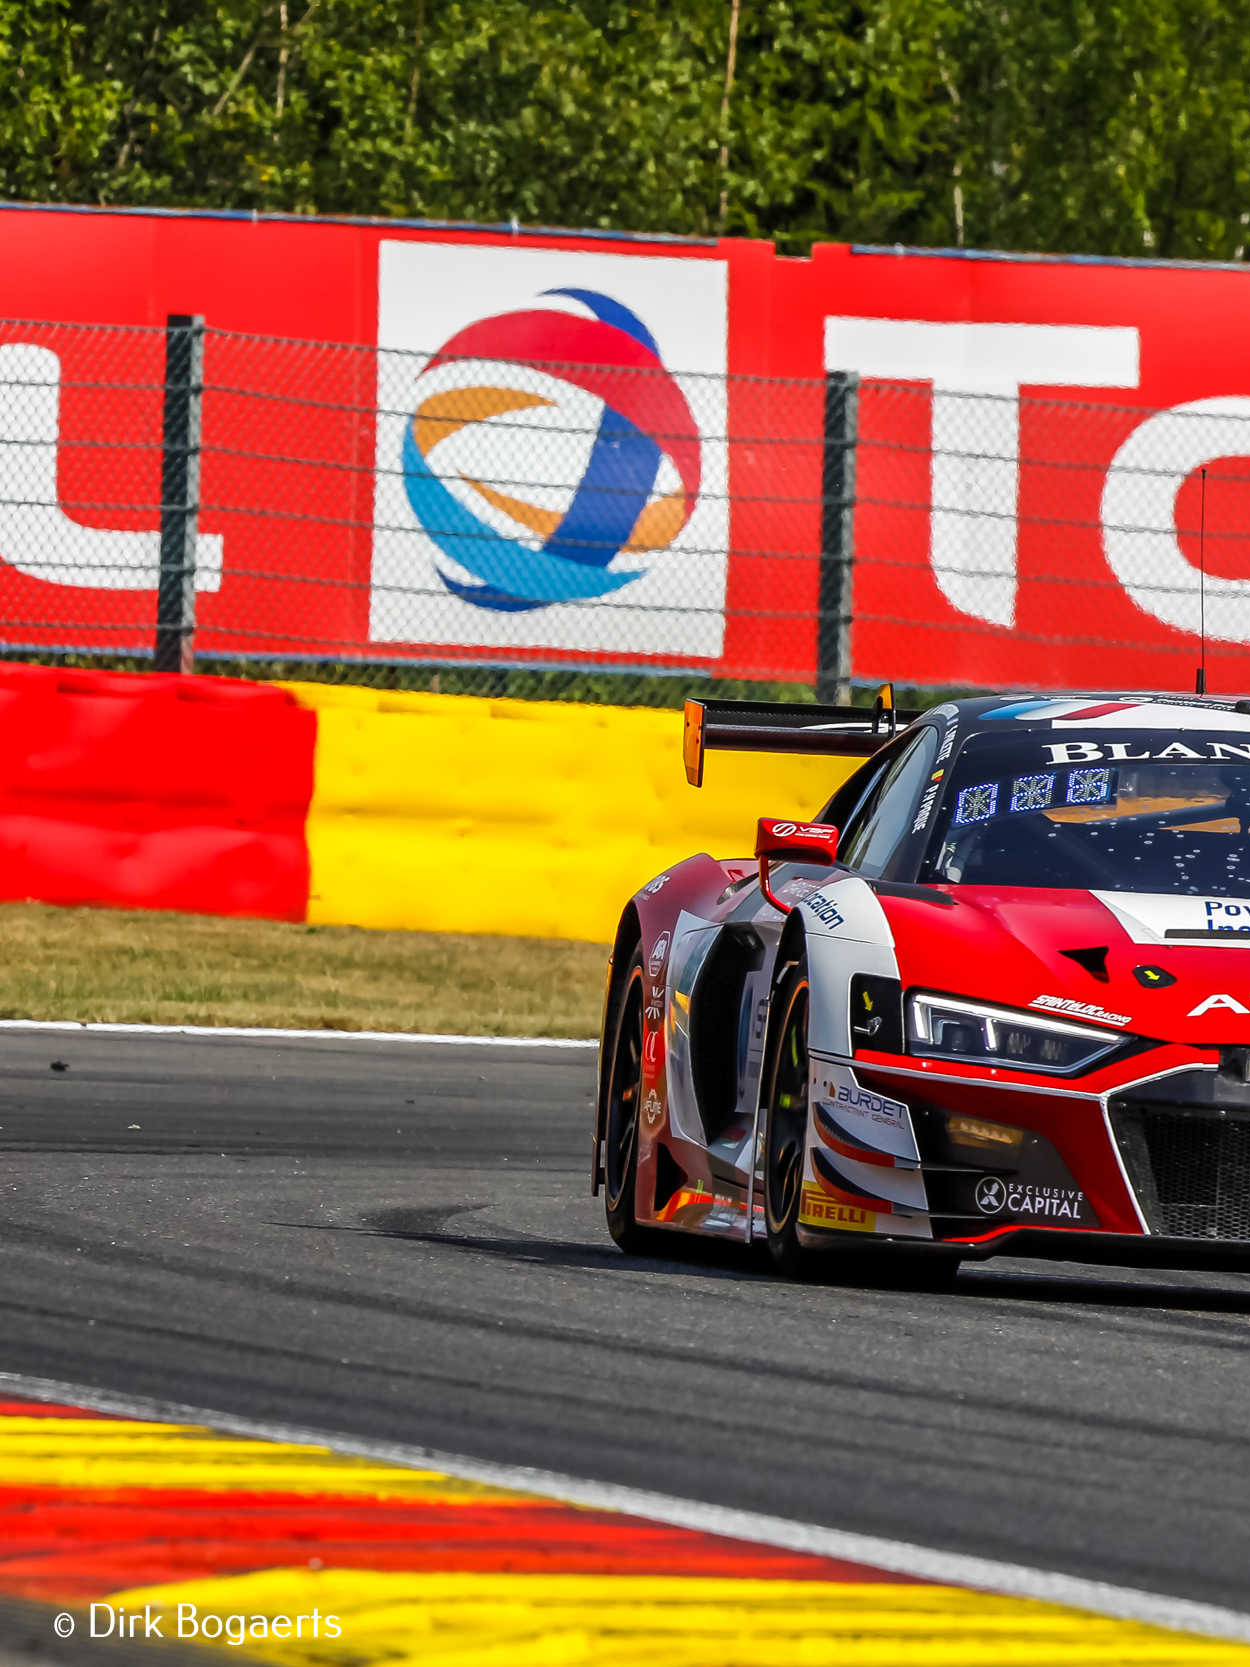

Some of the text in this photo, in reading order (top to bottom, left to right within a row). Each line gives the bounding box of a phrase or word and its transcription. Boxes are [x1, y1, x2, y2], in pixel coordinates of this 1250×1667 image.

[838, 1086, 907, 1119] BURDET
[1008, 1183, 1083, 1200] EXCLUSIVE
[1007, 1194, 1081, 1219] CAPITAL
